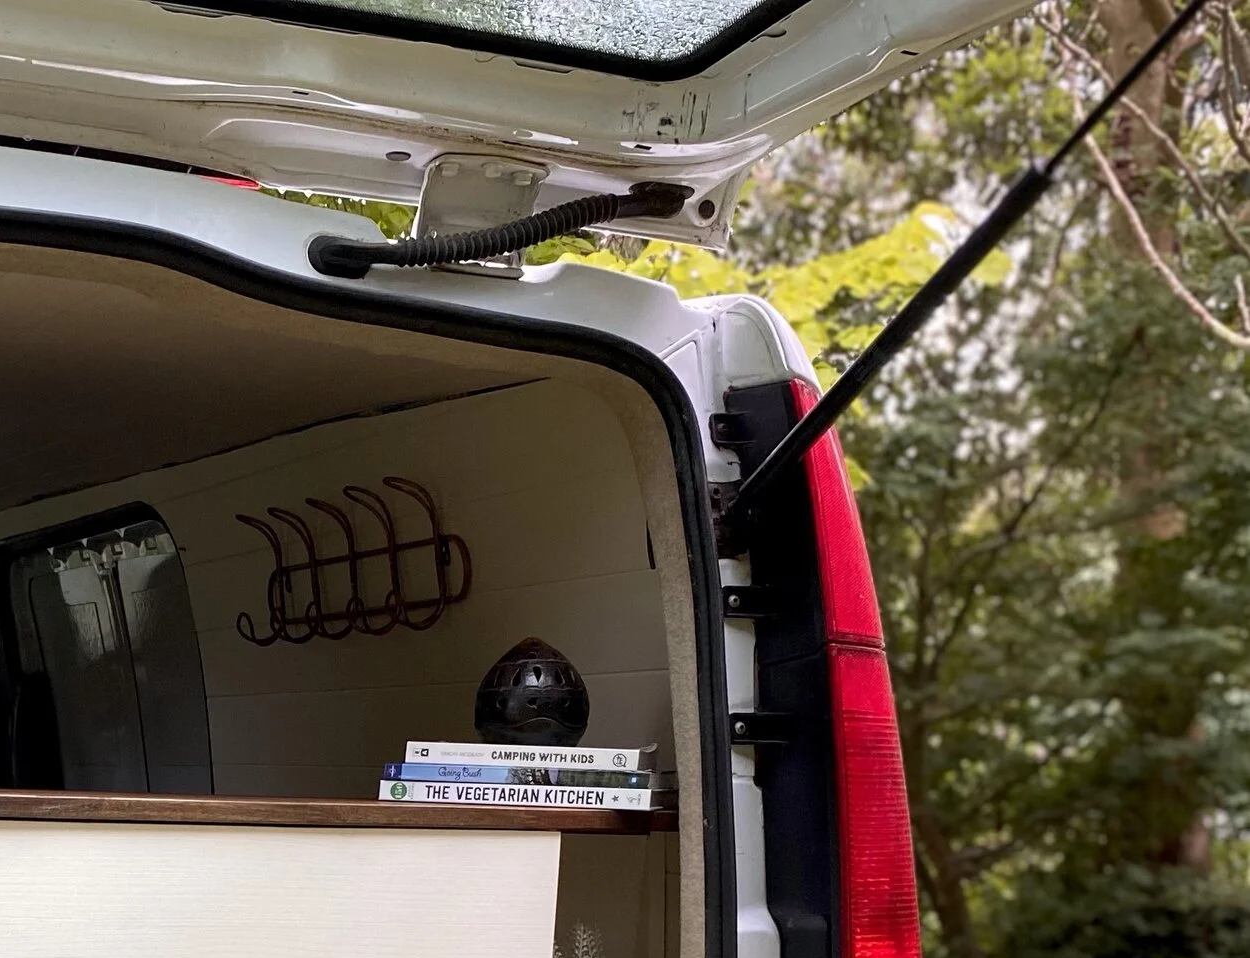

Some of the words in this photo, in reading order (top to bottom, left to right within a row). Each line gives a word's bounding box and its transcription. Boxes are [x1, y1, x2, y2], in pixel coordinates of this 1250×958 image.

[492, 751, 536, 762] CAMPING
[538, 752, 567, 763] WITH
[570, 753, 595, 764] KIDS
[438, 767, 461, 780] Going
[462, 767, 482, 778] Bush
[426, 785, 450, 801] THE
[457, 787, 540, 803] VEGETARIAN
[544, 789, 604, 806] KITCHEN
